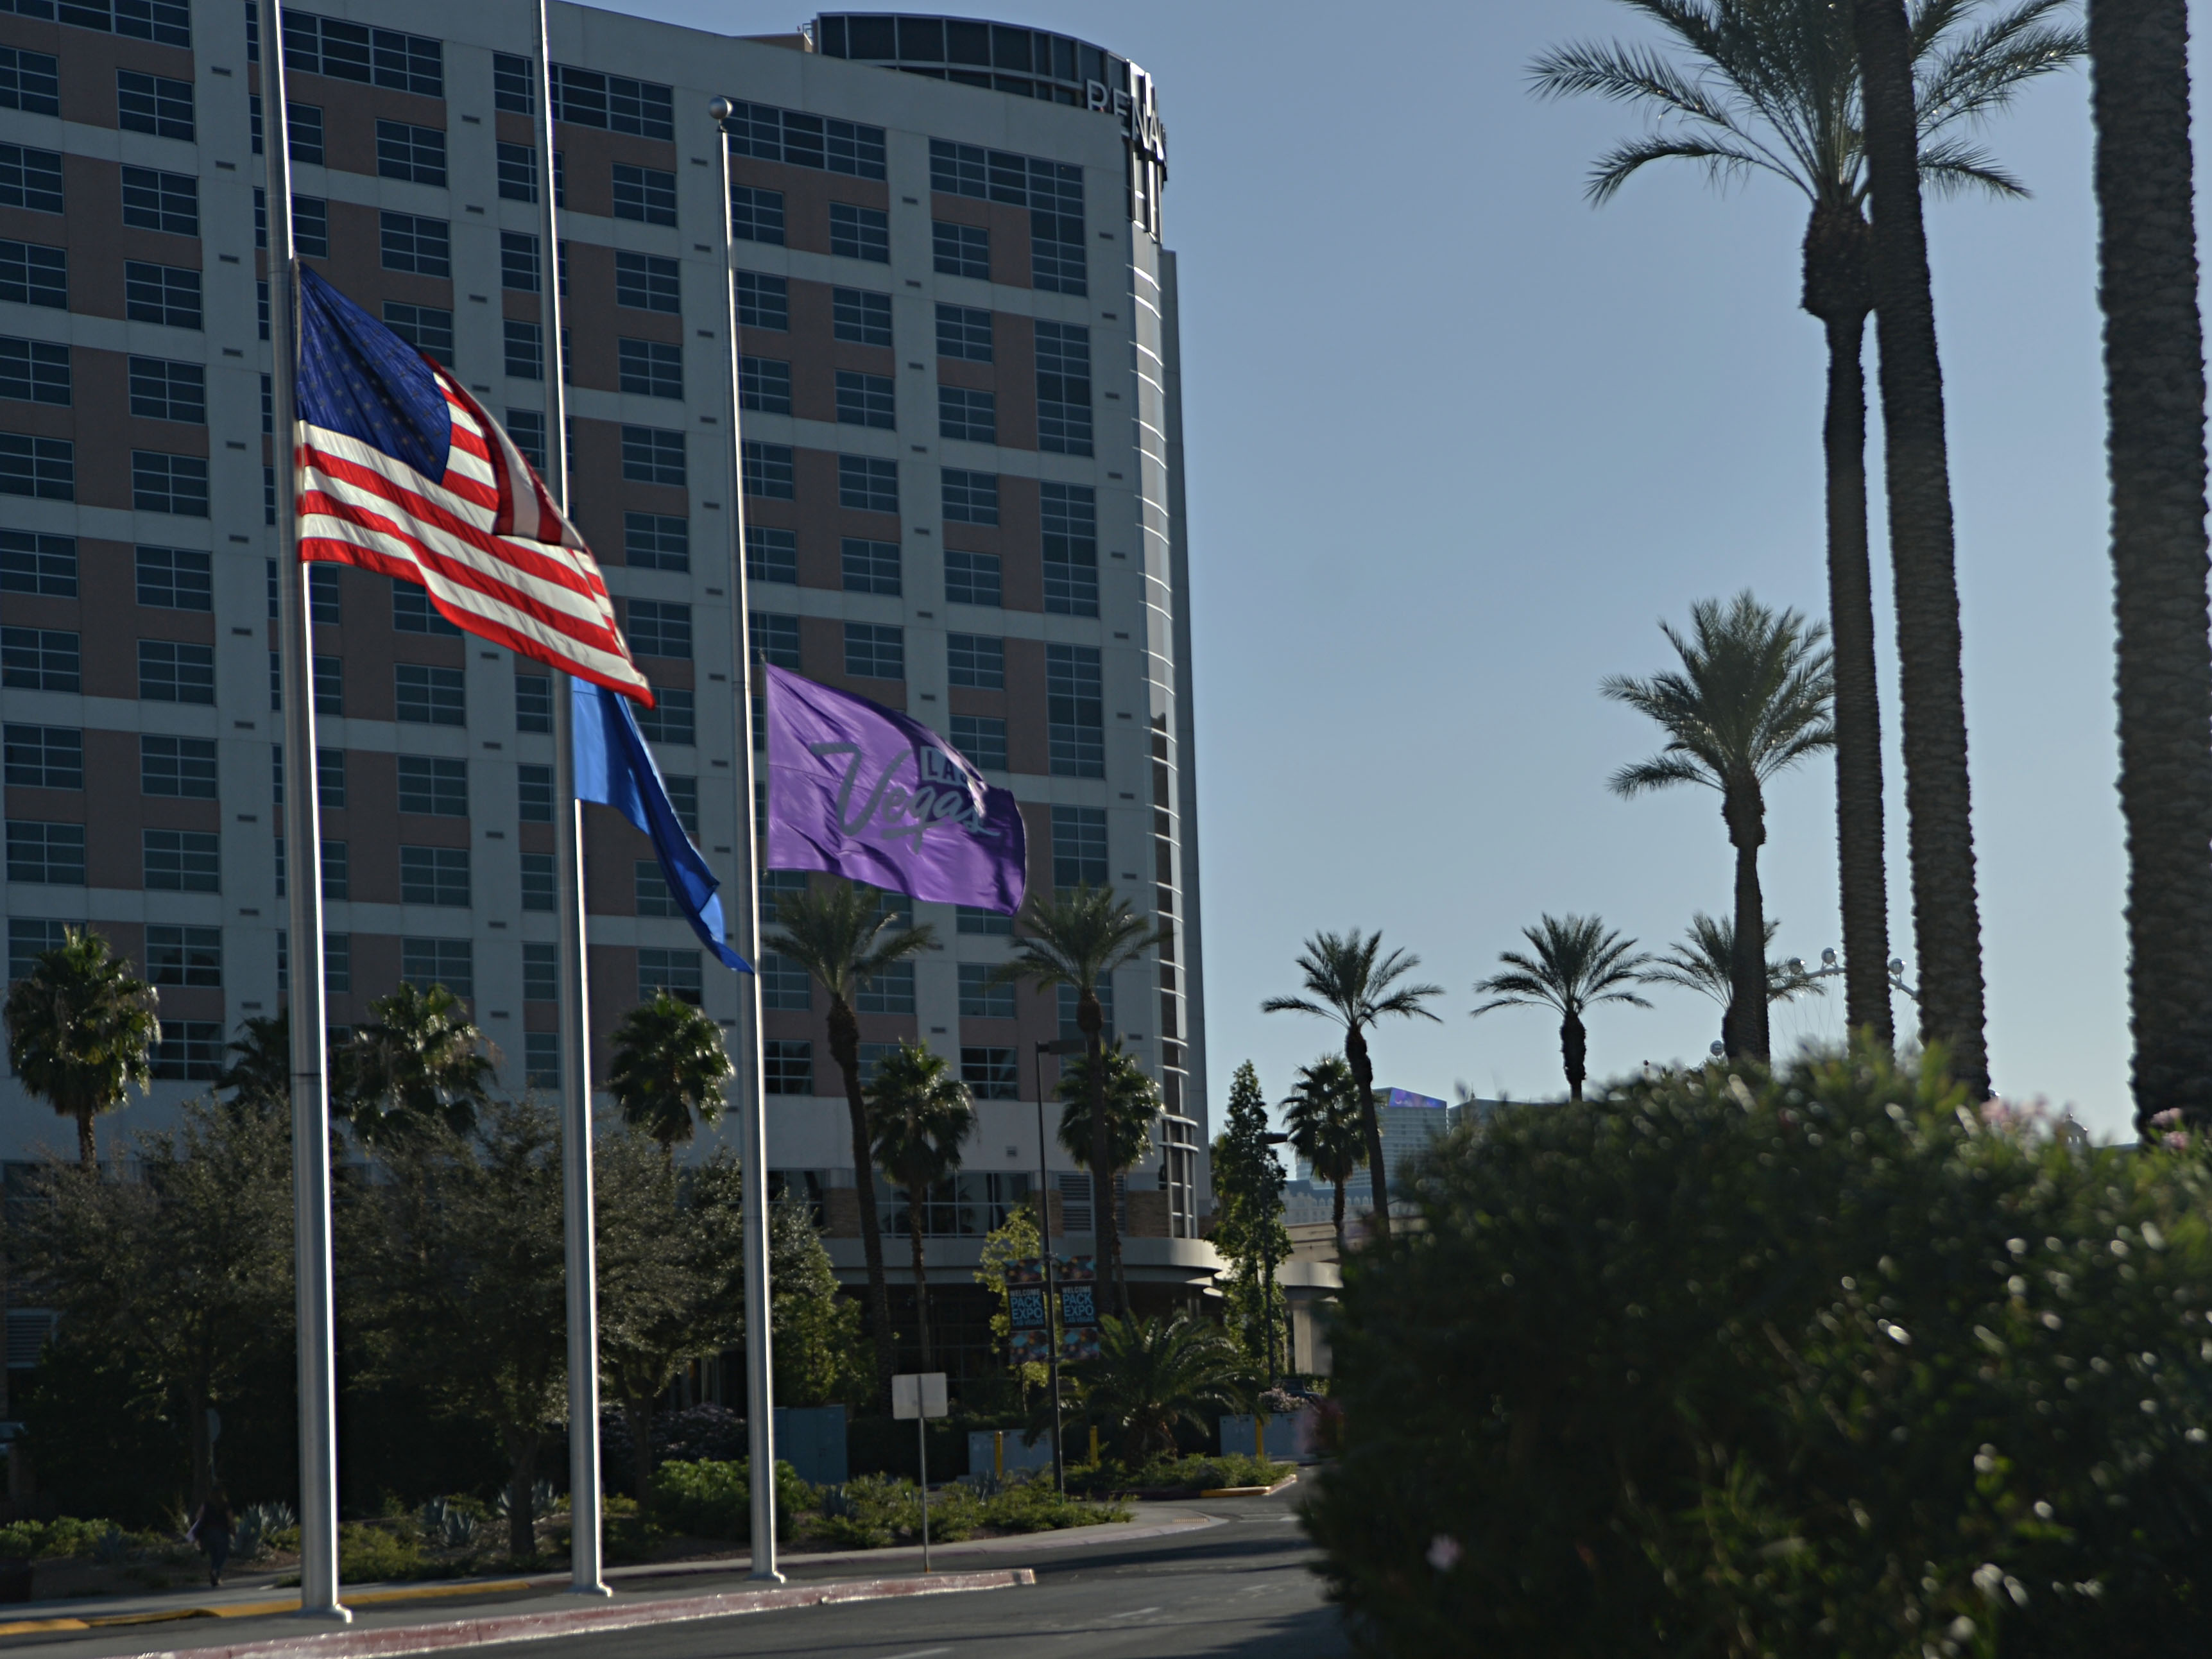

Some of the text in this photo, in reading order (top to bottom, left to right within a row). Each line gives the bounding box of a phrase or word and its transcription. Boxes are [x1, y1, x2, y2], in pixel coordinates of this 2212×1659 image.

[810, 742, 1000, 855] Vegas
[1009, 1288, 1041, 1296] WELCOME
[1062, 1285, 1091, 1294] WELCOME
[1010, 1296, 1042, 1308] PACK
[1063, 1293, 1093, 1305] PACK
[1011, 1307, 1043, 1319] EXPO
[1063, 1305, 1094, 1317] EXPO
